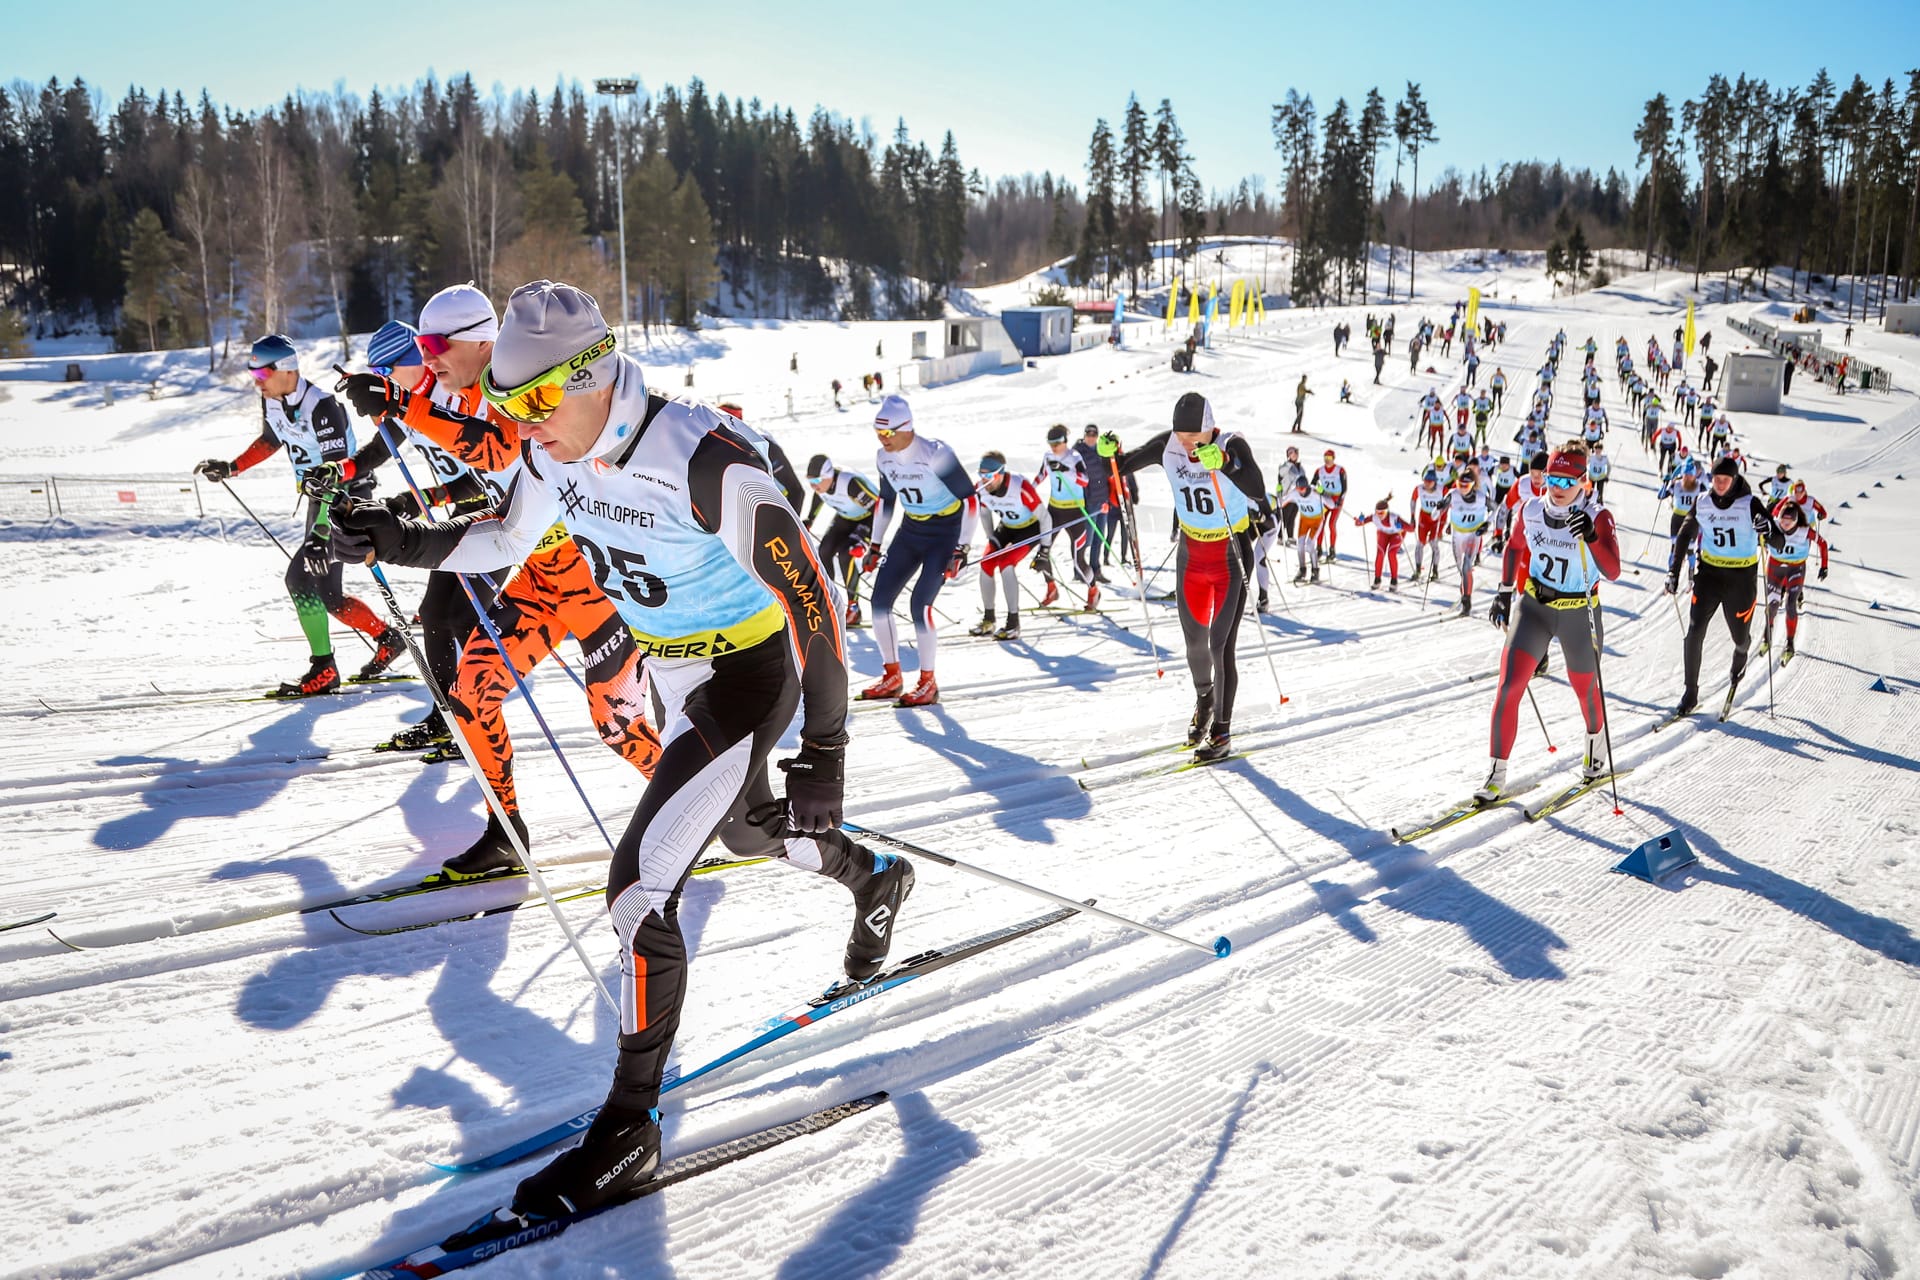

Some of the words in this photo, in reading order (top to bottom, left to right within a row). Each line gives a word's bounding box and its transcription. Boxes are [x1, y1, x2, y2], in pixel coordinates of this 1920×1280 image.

[898, 487, 923, 504] 17
[1179, 486, 1215, 516] 16
[1680, 495, 1693, 506] 18
[586, 497, 656, 529] LATLOPPET
[1712, 527, 1737, 548] 51
[571, 534, 669, 608] 25
[764, 535, 823, 633] RAIMAKS
[1538, 552, 1570, 585] 27
